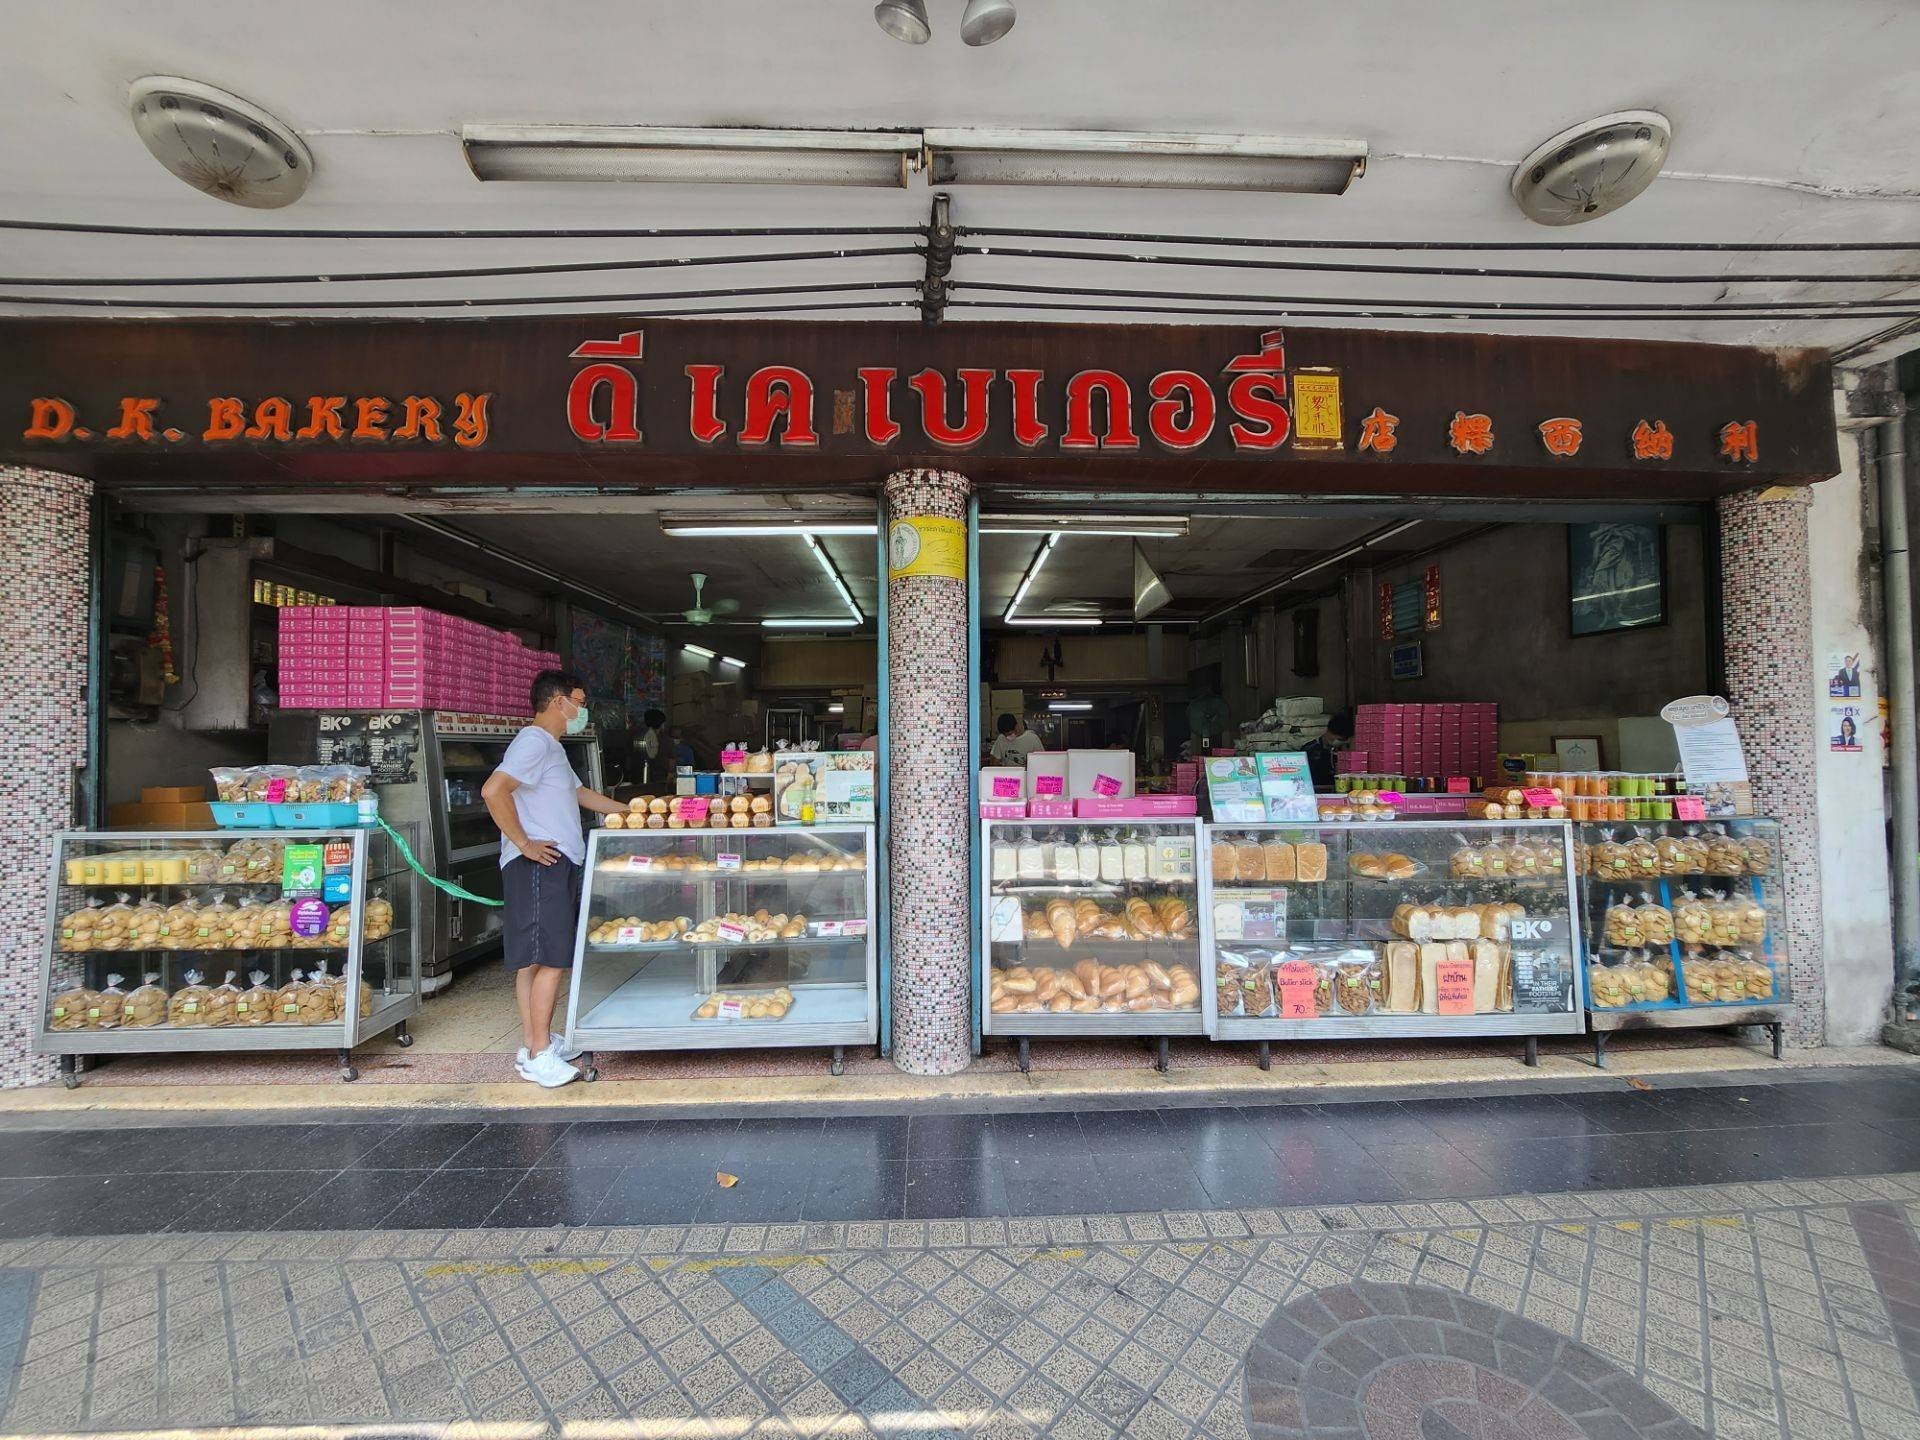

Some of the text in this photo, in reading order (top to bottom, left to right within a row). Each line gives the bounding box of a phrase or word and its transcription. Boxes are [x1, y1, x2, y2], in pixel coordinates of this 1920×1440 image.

[566, 329, 1292, 450] ดี เค เบเกอรี่
[24, 392, 493, 448] D. K. BAKERY
[320, 716, 342, 731] BK
[369, 714, 394, 730] BK
[1511, 920, 1542, 938] BK
